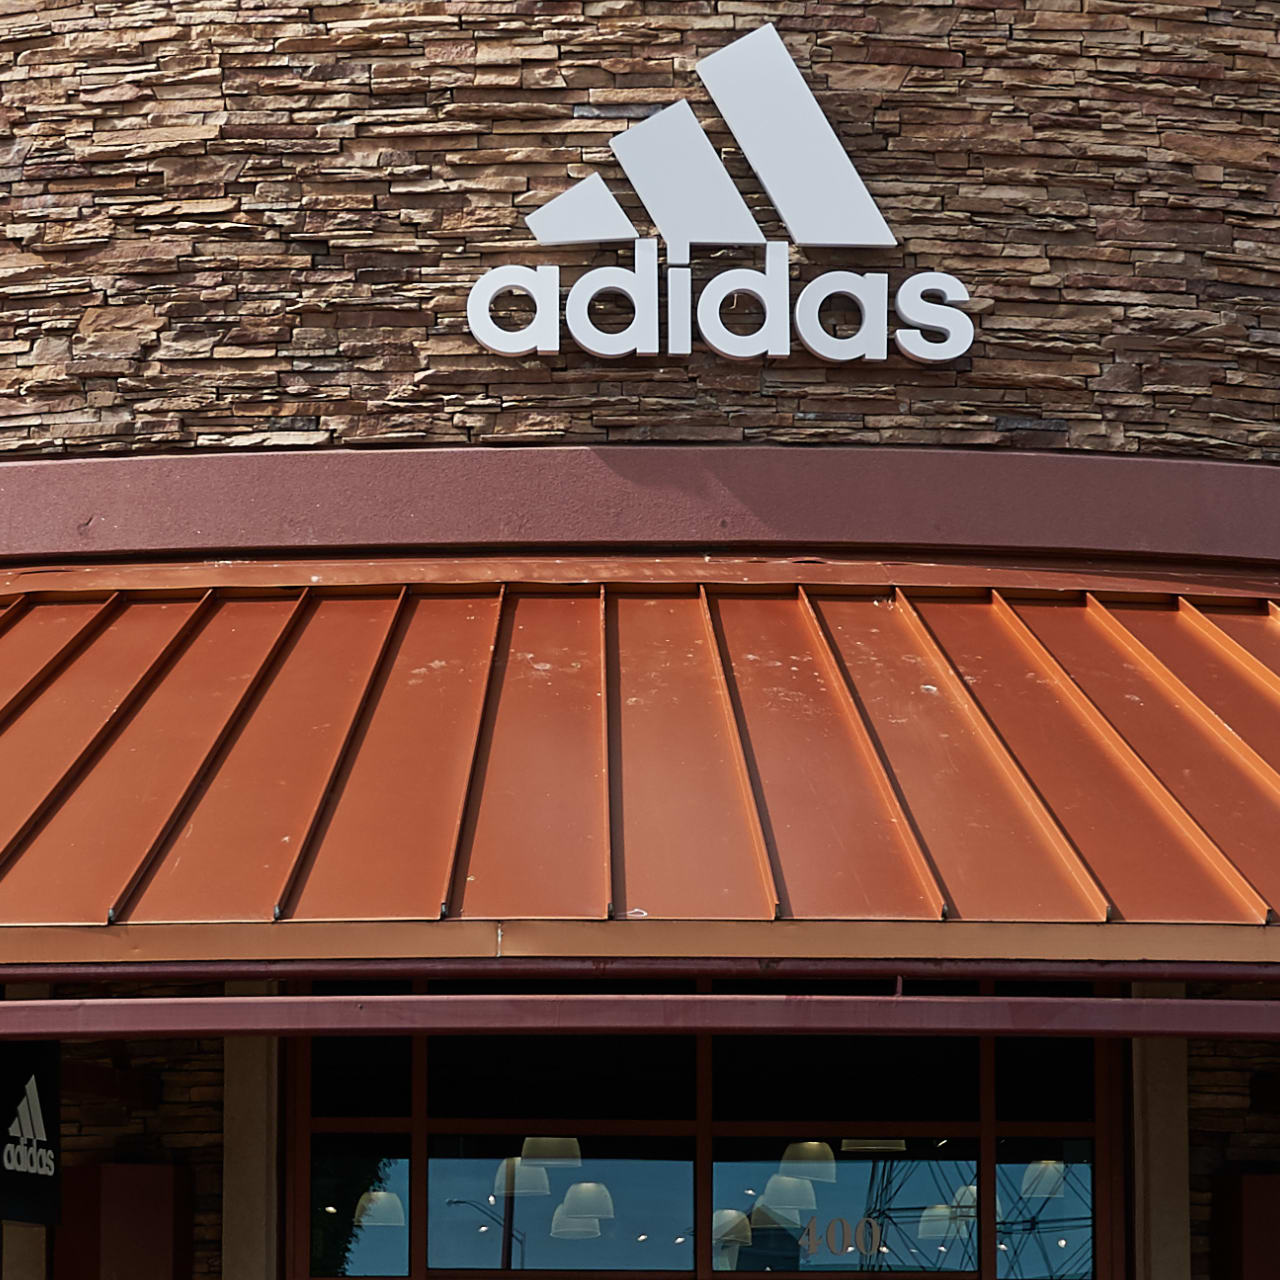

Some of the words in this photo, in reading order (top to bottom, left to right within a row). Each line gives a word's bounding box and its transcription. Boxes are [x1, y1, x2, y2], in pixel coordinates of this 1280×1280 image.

[466, 237, 975, 363] adidas
[3, 1136, 55, 1177] adidas
[797, 1216, 880, 1256] 400
